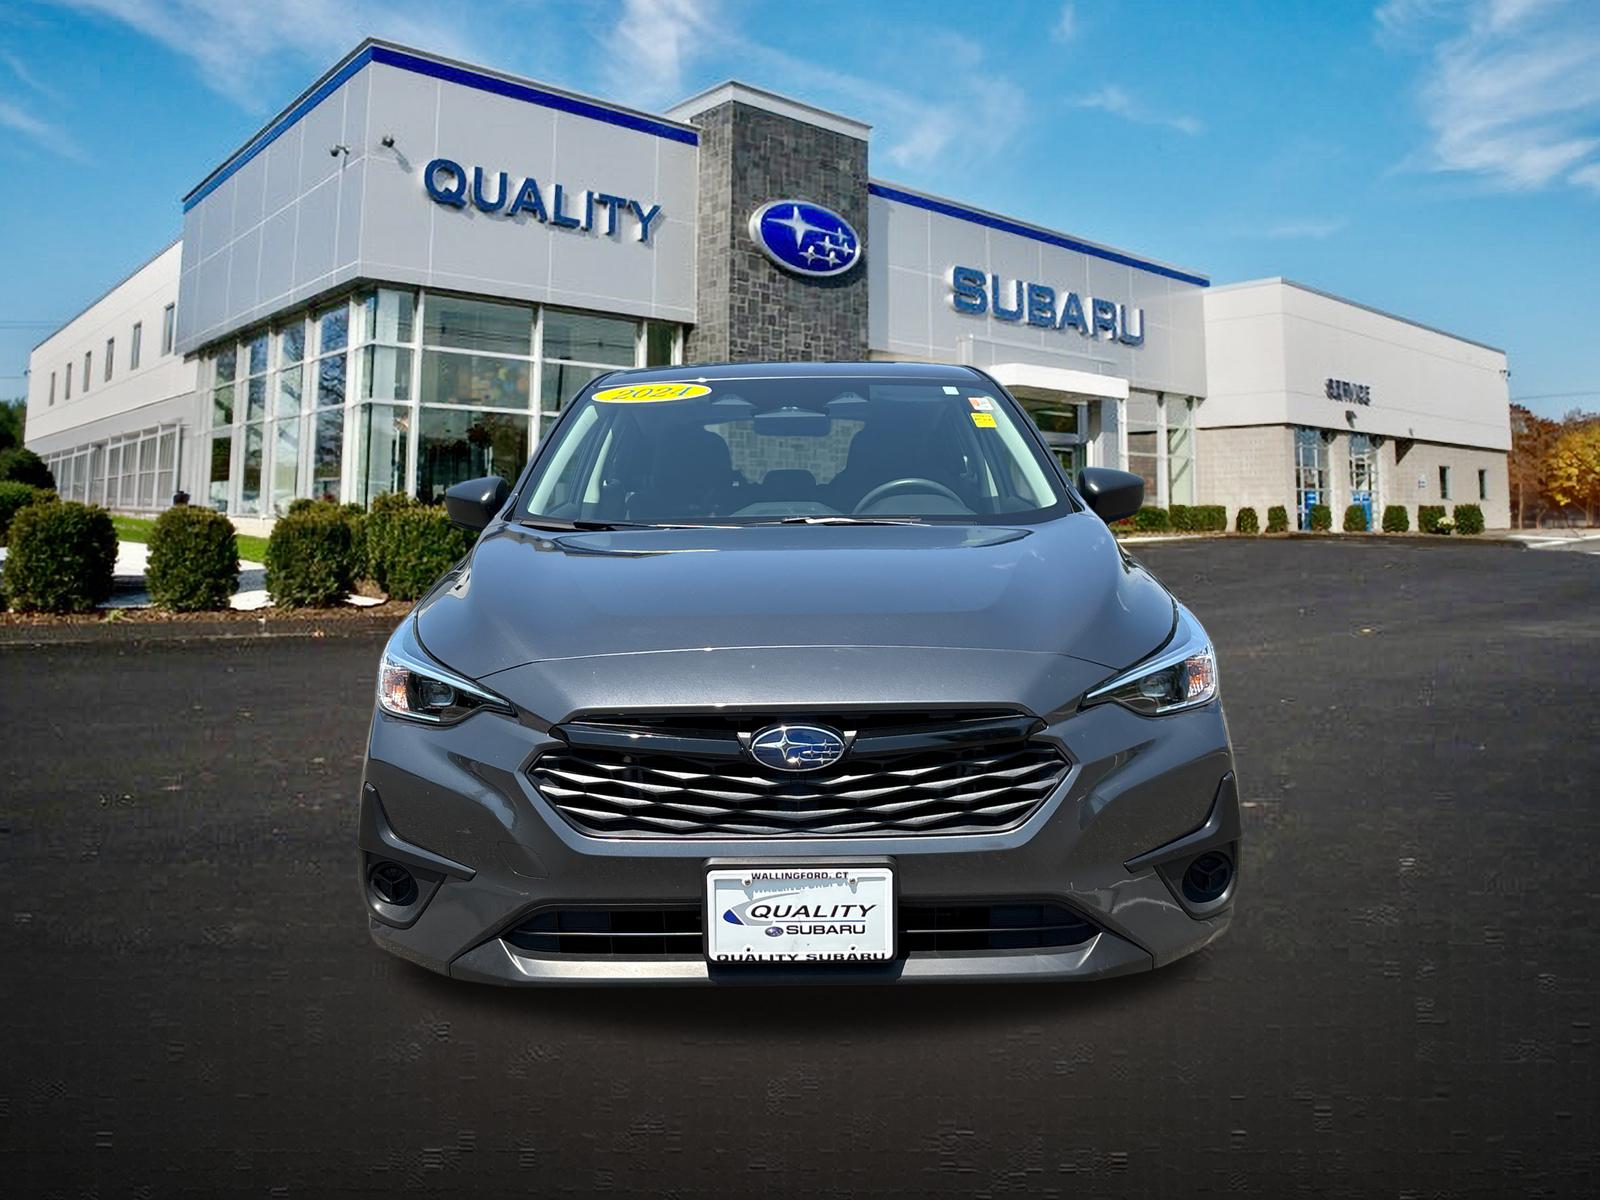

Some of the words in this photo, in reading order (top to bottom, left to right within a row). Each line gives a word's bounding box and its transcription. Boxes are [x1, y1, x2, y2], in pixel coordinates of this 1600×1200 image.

[424, 158, 661, 242] QUALITY
[951, 265, 1145, 346] SUBARU
[611, 386, 693, 400] 2024
[1325, 378, 1371, 406] SERVICE
[835, 871, 849, 879] CT
[750, 904, 877, 919] QUALITY
[786, 925, 866, 935] SUBARU
[717, 953, 799, 962] QUALITY
[806, 952, 885, 961] SUBARU
